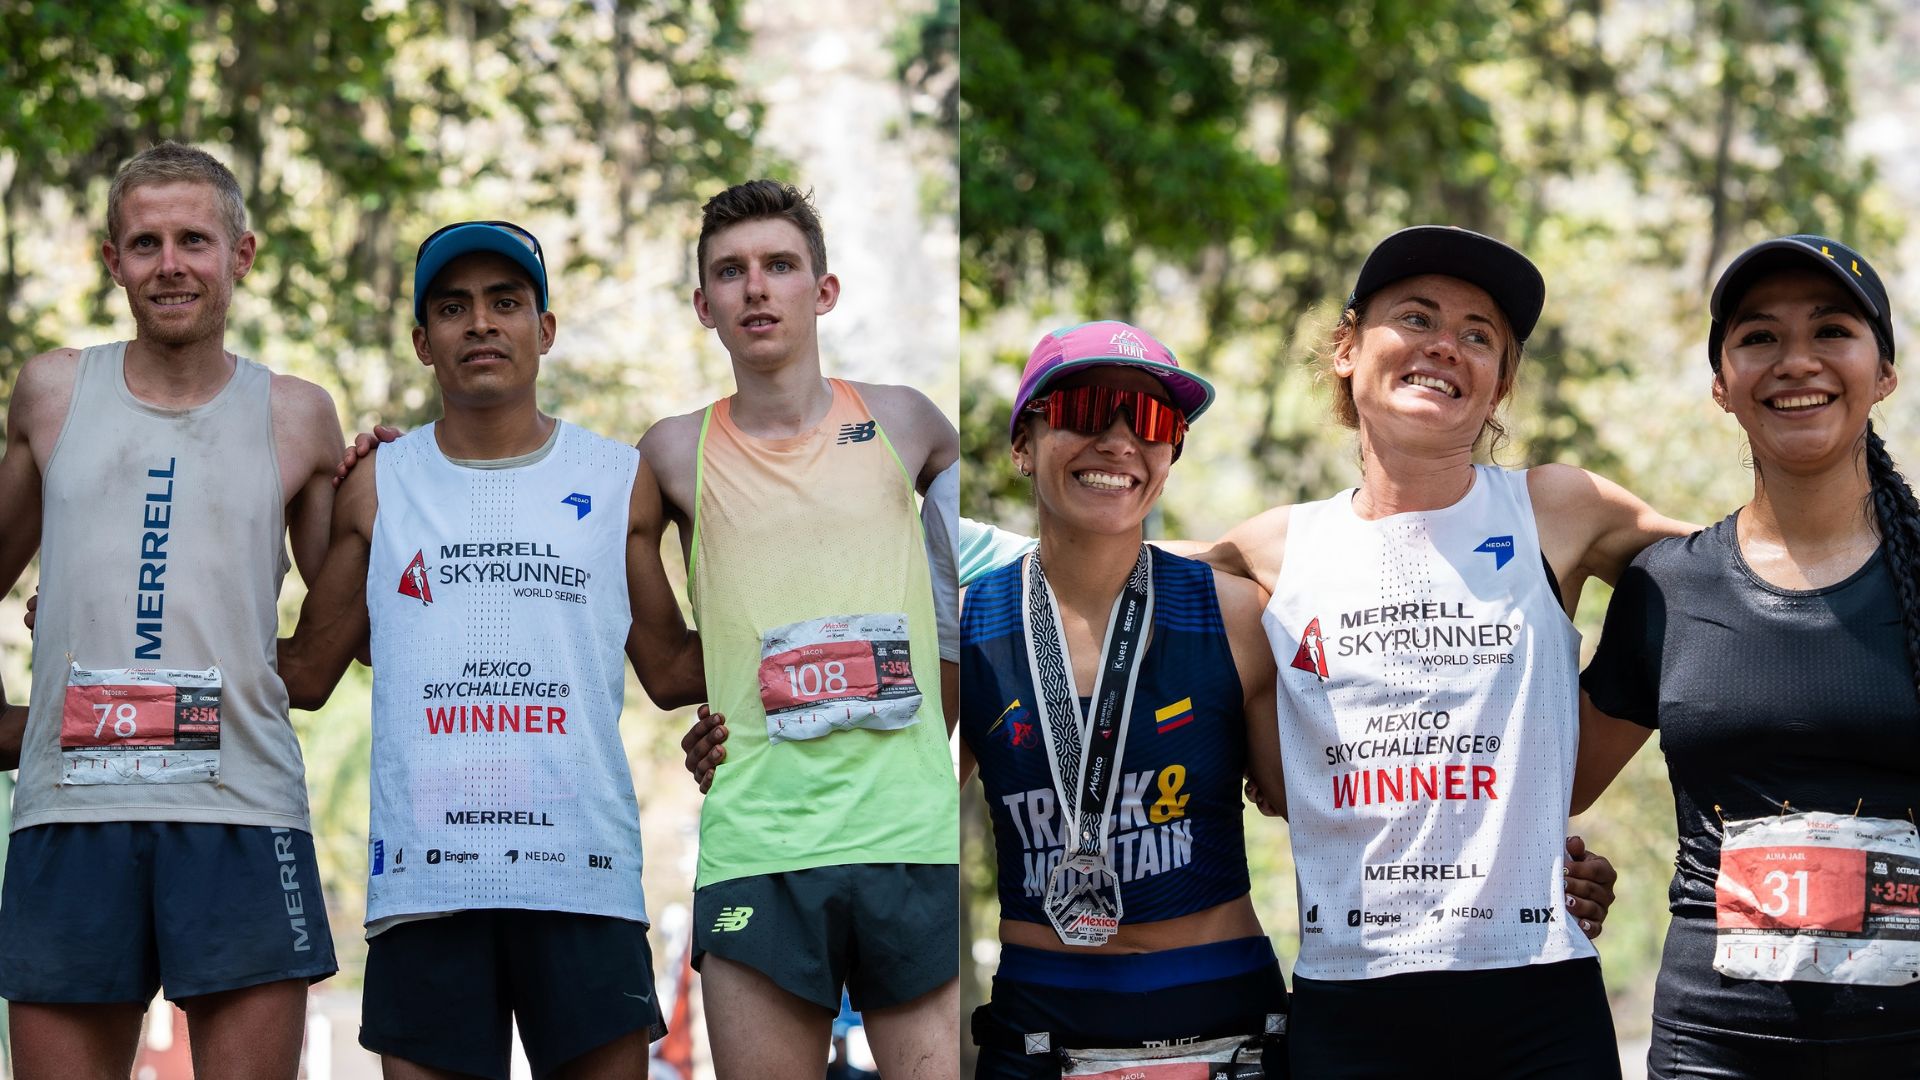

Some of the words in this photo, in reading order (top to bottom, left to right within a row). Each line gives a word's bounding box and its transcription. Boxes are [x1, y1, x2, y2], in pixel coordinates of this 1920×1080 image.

[570, 496, 590, 504] NEDAO
[440, 542, 560, 559] MERRELL
[1485, 541, 1511, 549] NEDAO
[134, 457, 176, 660] MERRELL
[513, 587, 553, 598] WORLD
[555, 590, 587, 605] SERIES
[1123, 600, 1136, 632] SECTUR
[1340, 602, 1474, 629] MERRELL
[1113, 641, 1129, 670] Kuest
[1421, 654, 1469, 667] WORLD
[1473, 653, 1515, 665] SERIES
[462, 662, 531, 677] MEXICO
[880, 660, 911, 676] +35K
[784, 661, 849, 698] 108
[92, 703, 137, 739] 78
[180, 706, 219, 722] +35K
[426, 704, 567, 734] WINNER
[1365, 710, 1450, 734] MEXICO
[1332, 764, 1498, 809] WINNER
[445, 811, 554, 826] MERRELL
[444, 850, 479, 862] Engine
[525, 851, 566, 863] NEDAO
[588, 854, 613, 870] BIX
[1022, 819, 1194, 897] MOTAIN
[1364, 864, 1486, 880] MERRELL
[270, 827, 311, 951] MERR
[1762, 869, 1809, 917] 31
[1872, 881, 1920, 903] +35K
[1364, 911, 1401, 925] Engine
[1451, 907, 1493, 919] NEDAO
[1519, 906, 1556, 923] BIX
